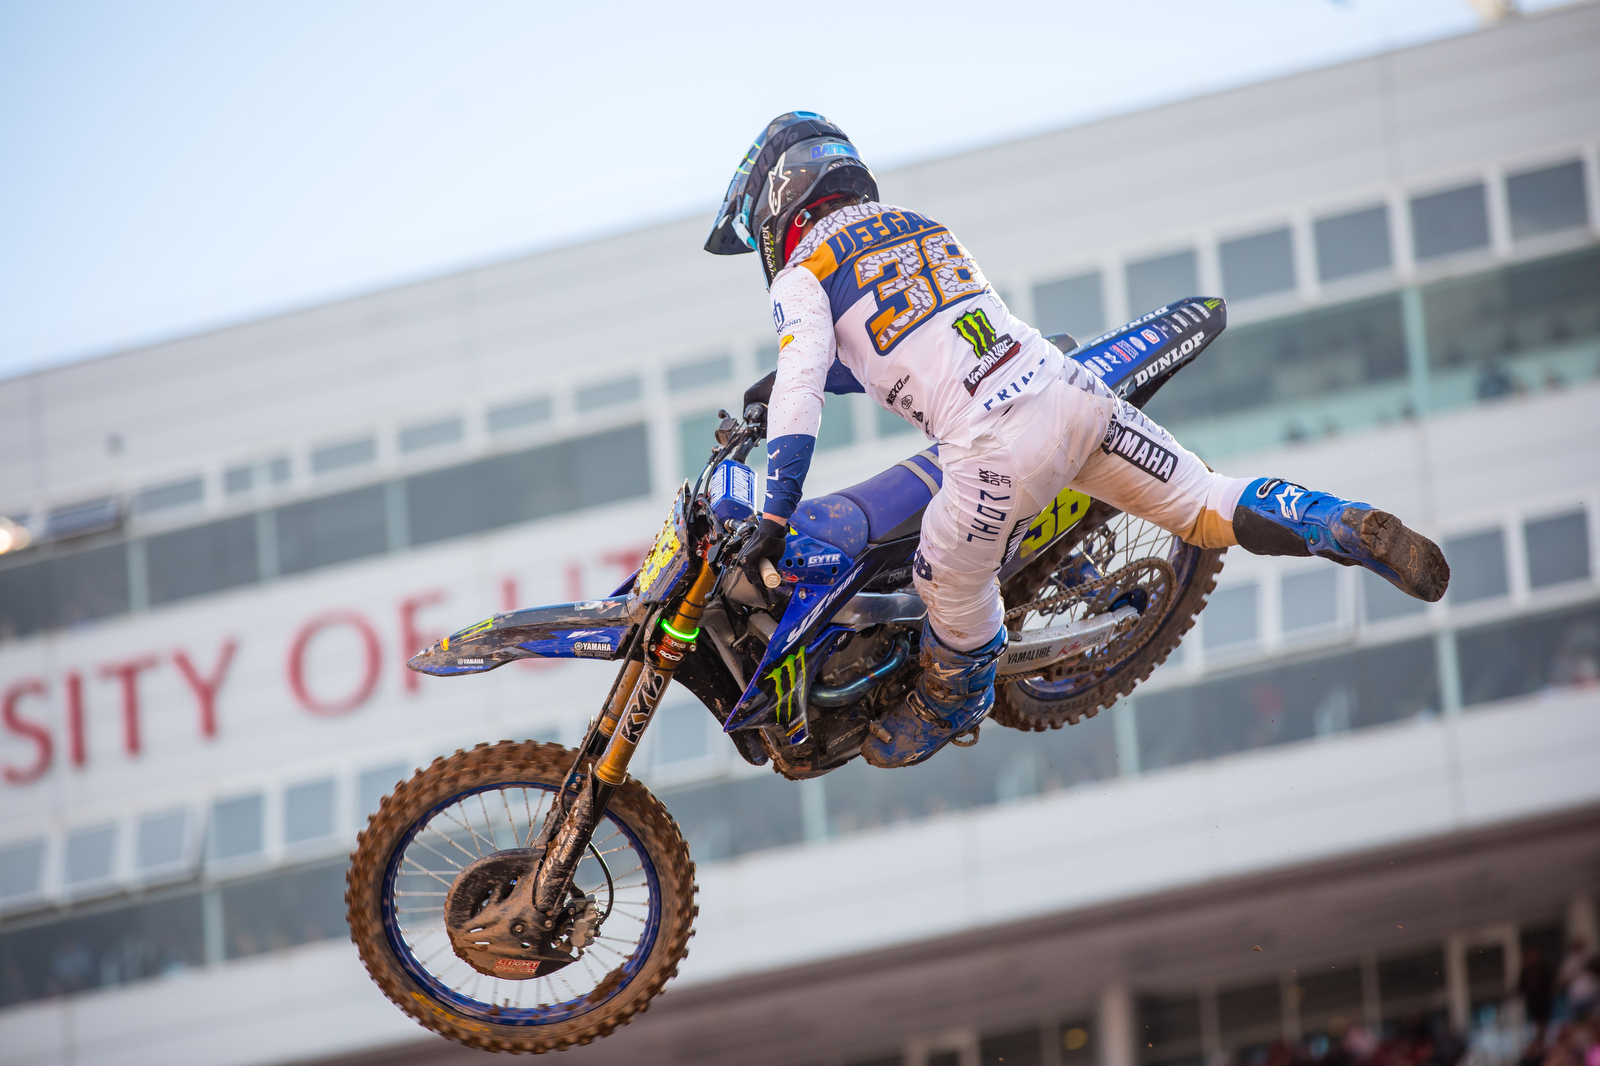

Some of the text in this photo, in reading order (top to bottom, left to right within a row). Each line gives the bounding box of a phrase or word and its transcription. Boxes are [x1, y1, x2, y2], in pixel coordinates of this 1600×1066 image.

[810, 143, 861, 160] DANG
[853, 231, 988, 353] 38
[1135, 331, 1205, 387] DUNLOP
[1107, 426, 1174, 481] YMAHA
[979, 468, 989, 483] MX
[990, 470, 1000, 487] DIV
[808, 553, 842, 565] GYTR
[583, 642, 611, 652] YAMAHA
[1007, 645, 1053, 665] YAMALUBE
[0, 633, 238, 785] SITY
[285, 588, 448, 718] OF
[620, 672, 665, 746] KYB
